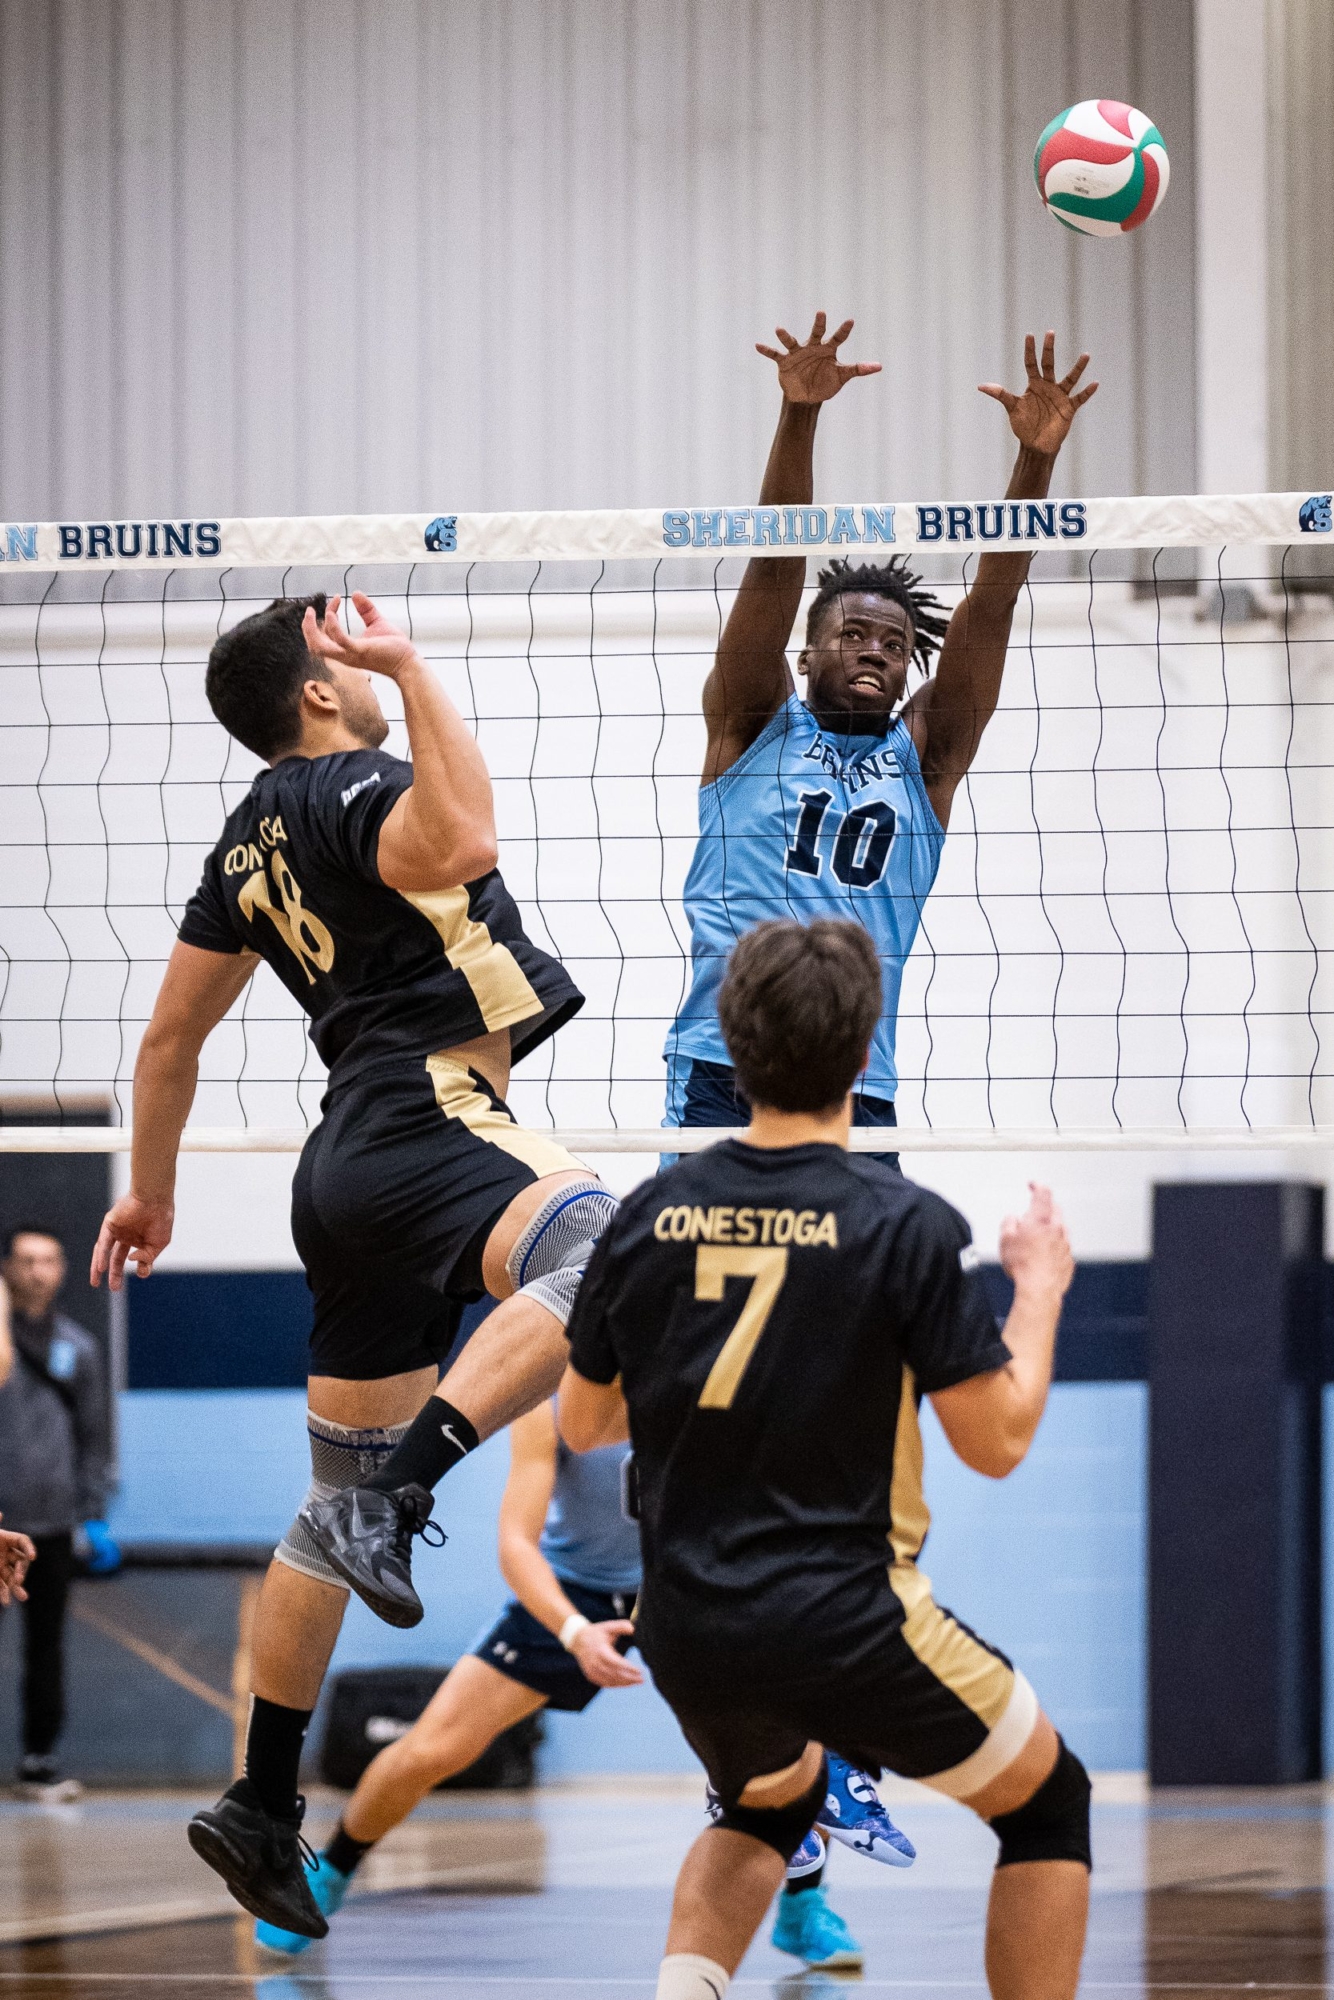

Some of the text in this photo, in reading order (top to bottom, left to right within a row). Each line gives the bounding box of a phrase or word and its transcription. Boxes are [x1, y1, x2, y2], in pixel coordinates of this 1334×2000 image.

[58, 521, 222, 560] BRUINS
[663, 502, 1088, 547] SHERIDAN BRUINS
[783, 787, 898, 892] 10
[237, 849, 335, 986] 18
[653, 1205, 838, 1249] CONESTOGA
[694, 1244, 789, 1411] 7
